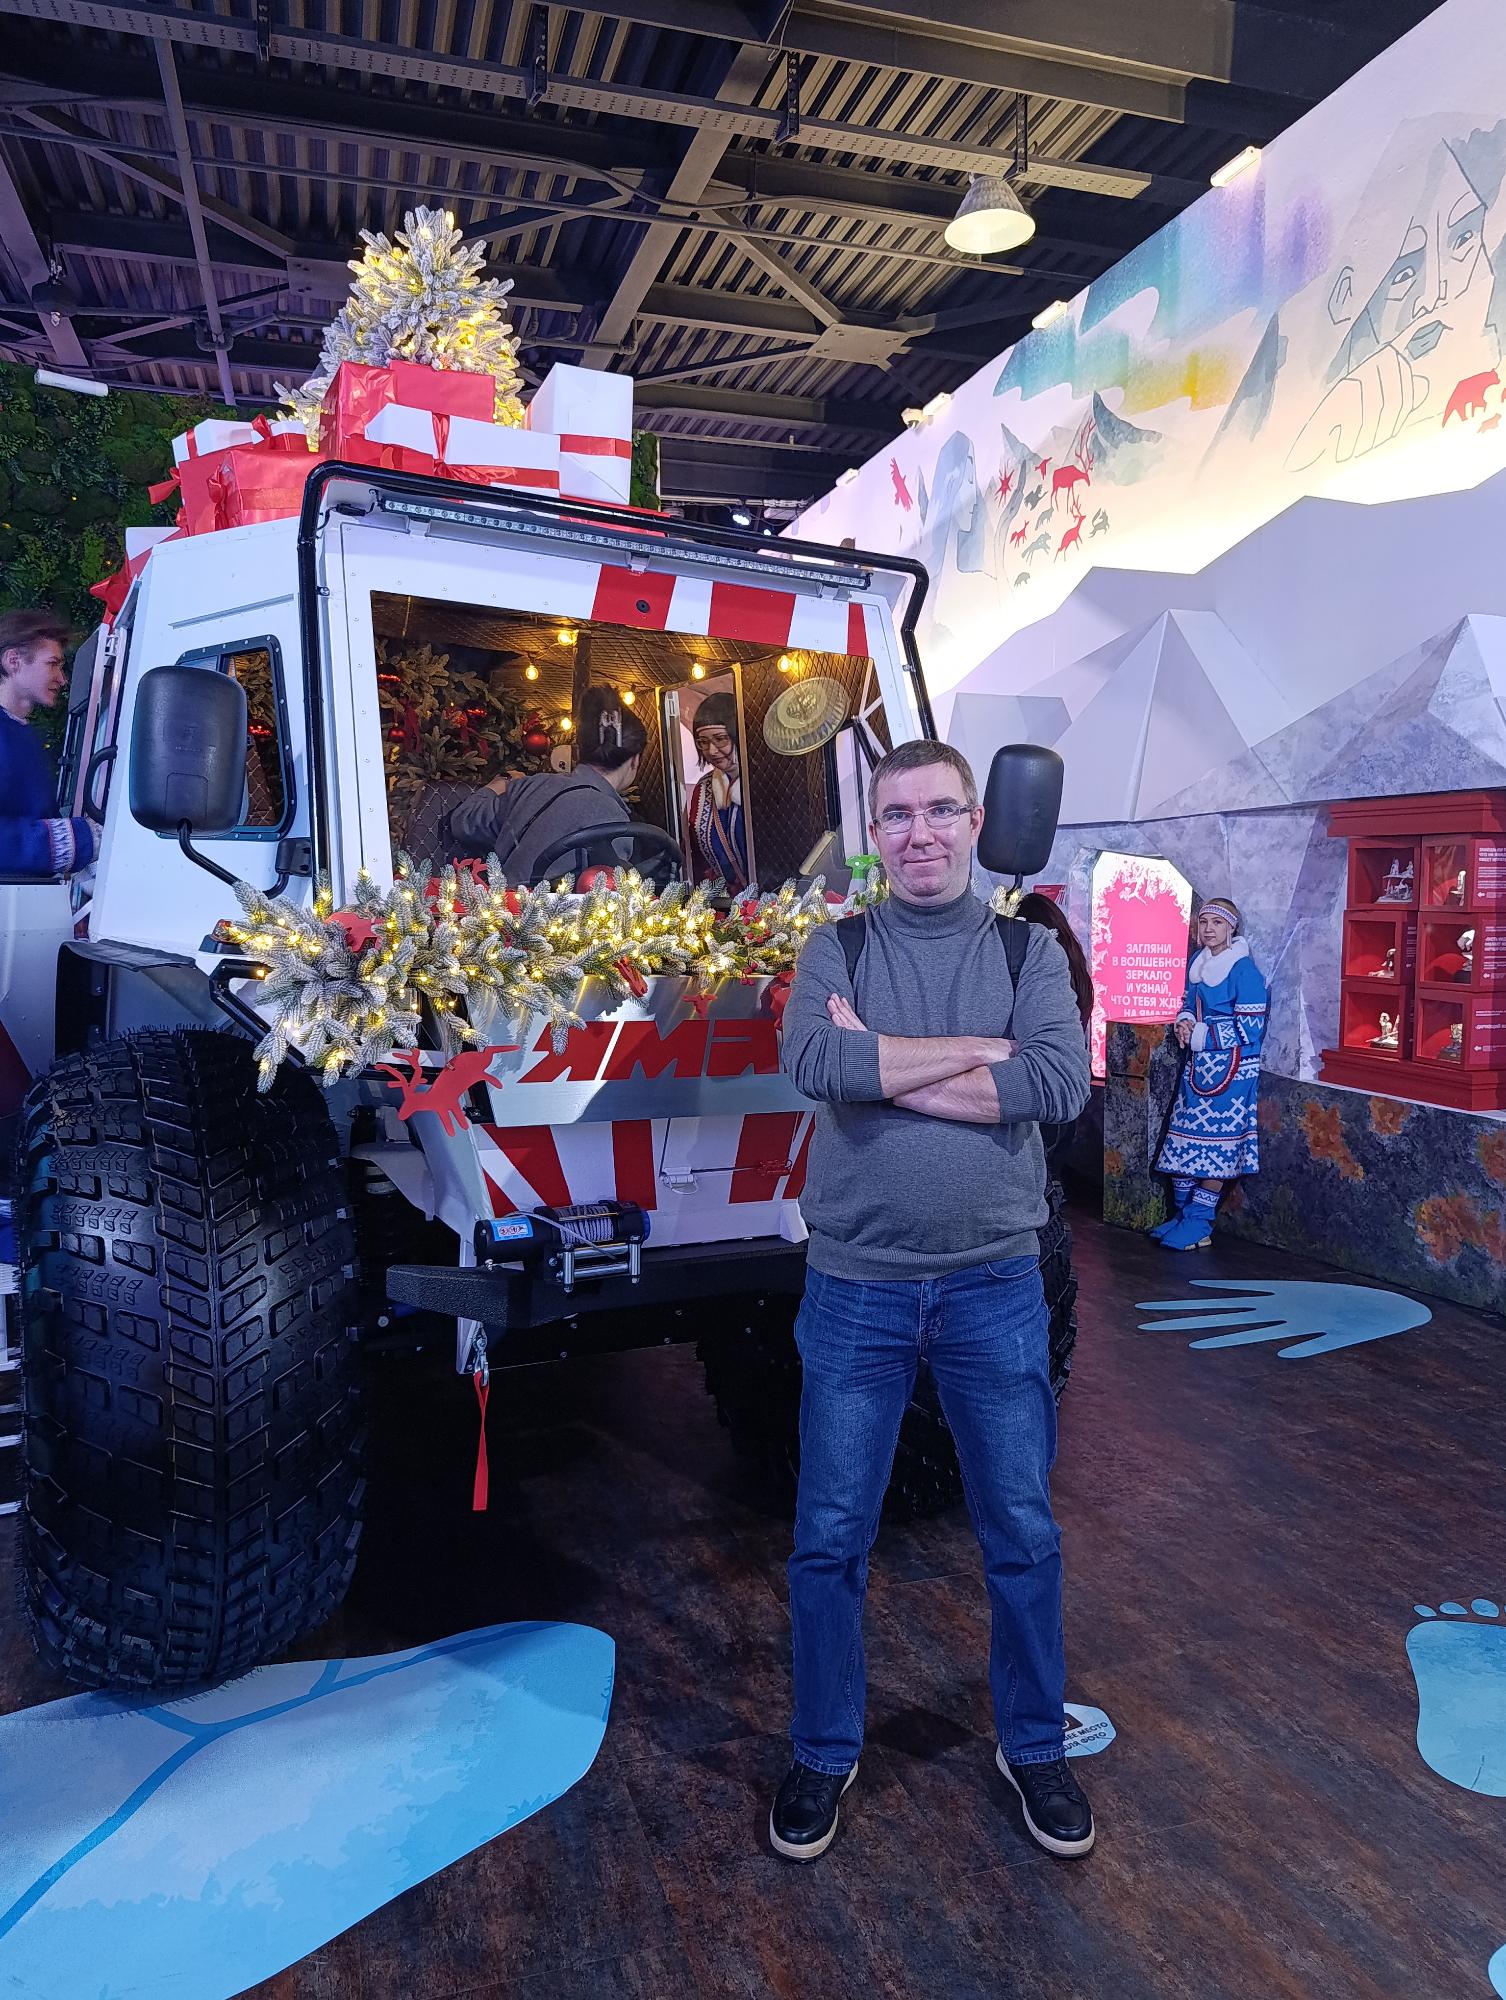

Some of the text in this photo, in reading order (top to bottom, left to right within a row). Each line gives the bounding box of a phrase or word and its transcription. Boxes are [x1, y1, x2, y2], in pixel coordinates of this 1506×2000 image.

[1126, 944, 1172, 954] ЗАГЛЯНИ
[1112, 957, 1187, 968] В ВОЛШЕБНОЕ
[1126, 970, 1172, 981] ЗЕРКАЛО
[1126, 982, 1172, 996] И УЗНАЙ,
[1111, 995, 1131, 1006] ЧТО
[1132, 996, 1157, 1007] ТЕБЯ
[1123, 1008, 1137, 1018] НА
[517, 1019, 788, 1084] ЯМА
[1077, 1722, 1108, 1736] МЕСТО
[1080, 1732, 1107, 1744] ФОТО
